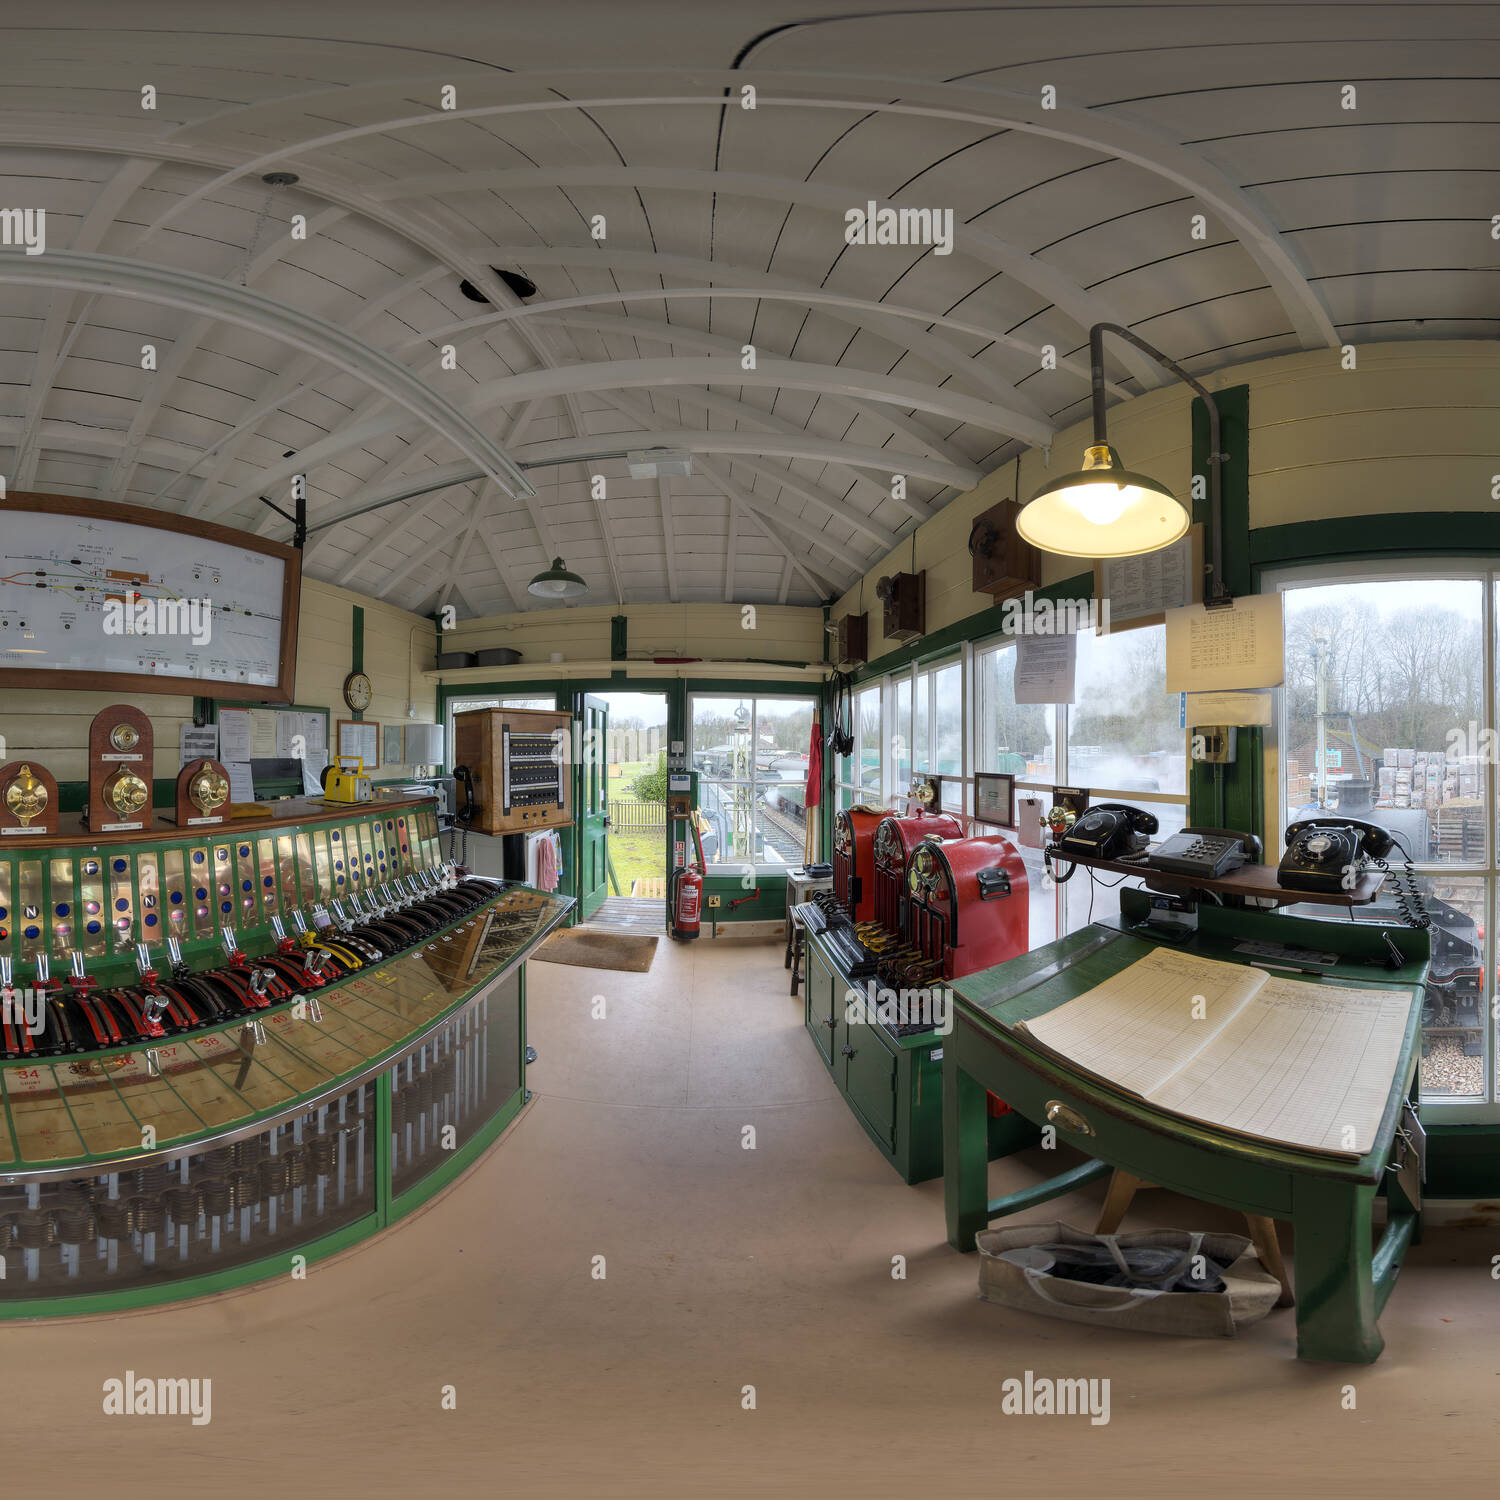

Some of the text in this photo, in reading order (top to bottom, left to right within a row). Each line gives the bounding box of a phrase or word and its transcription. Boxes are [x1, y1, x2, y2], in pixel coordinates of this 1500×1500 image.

[87, 863, 96, 872] F
[145, 897, 154, 907] N
[26, 907, 36, 917] N
[329, 991, 342, 1001] 42
[272, 1015, 287, 1024] 40
[200, 1037, 220, 1048] 38
[159, 1047, 177, 1058] 37
[18, 1069, 40, 1079] 34
[69, 1064, 90, 1074] 35
